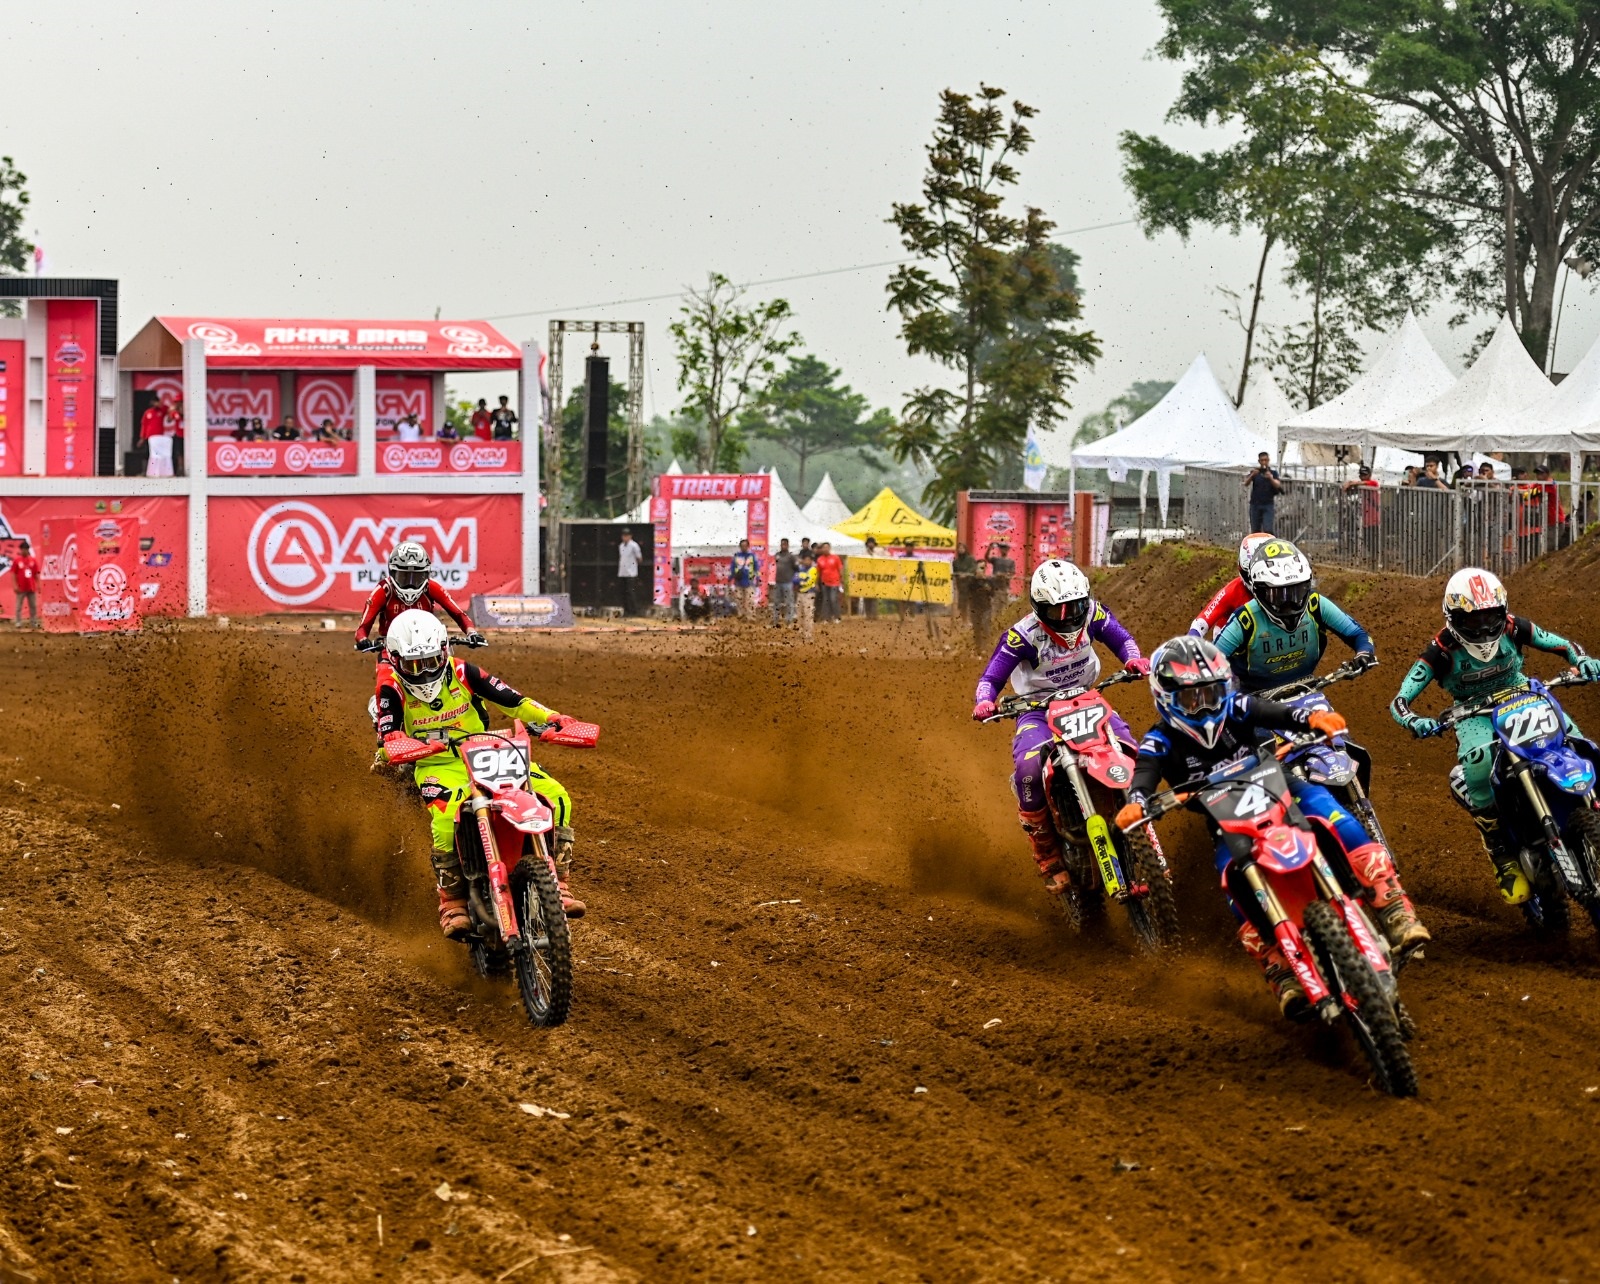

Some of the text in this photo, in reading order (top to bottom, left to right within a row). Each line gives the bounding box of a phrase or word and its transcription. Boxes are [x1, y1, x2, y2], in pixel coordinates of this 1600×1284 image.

[264, 328, 428, 344] AKAR MAS
[672, 479, 763, 496] TRACK IN
[890, 536, 954, 548] ACERBIS
[857, 573, 896, 583] DUNLOP
[910, 576, 949, 587] DULOP
[412, 702, 470, 726] Astra Honda
[1060, 706, 1104, 742] 317
[1504, 703, 1559, 747] 225
[472, 748, 527, 781] 94
[1233, 778, 1271, 818] 4
[479, 822, 493, 860] SHOWA
